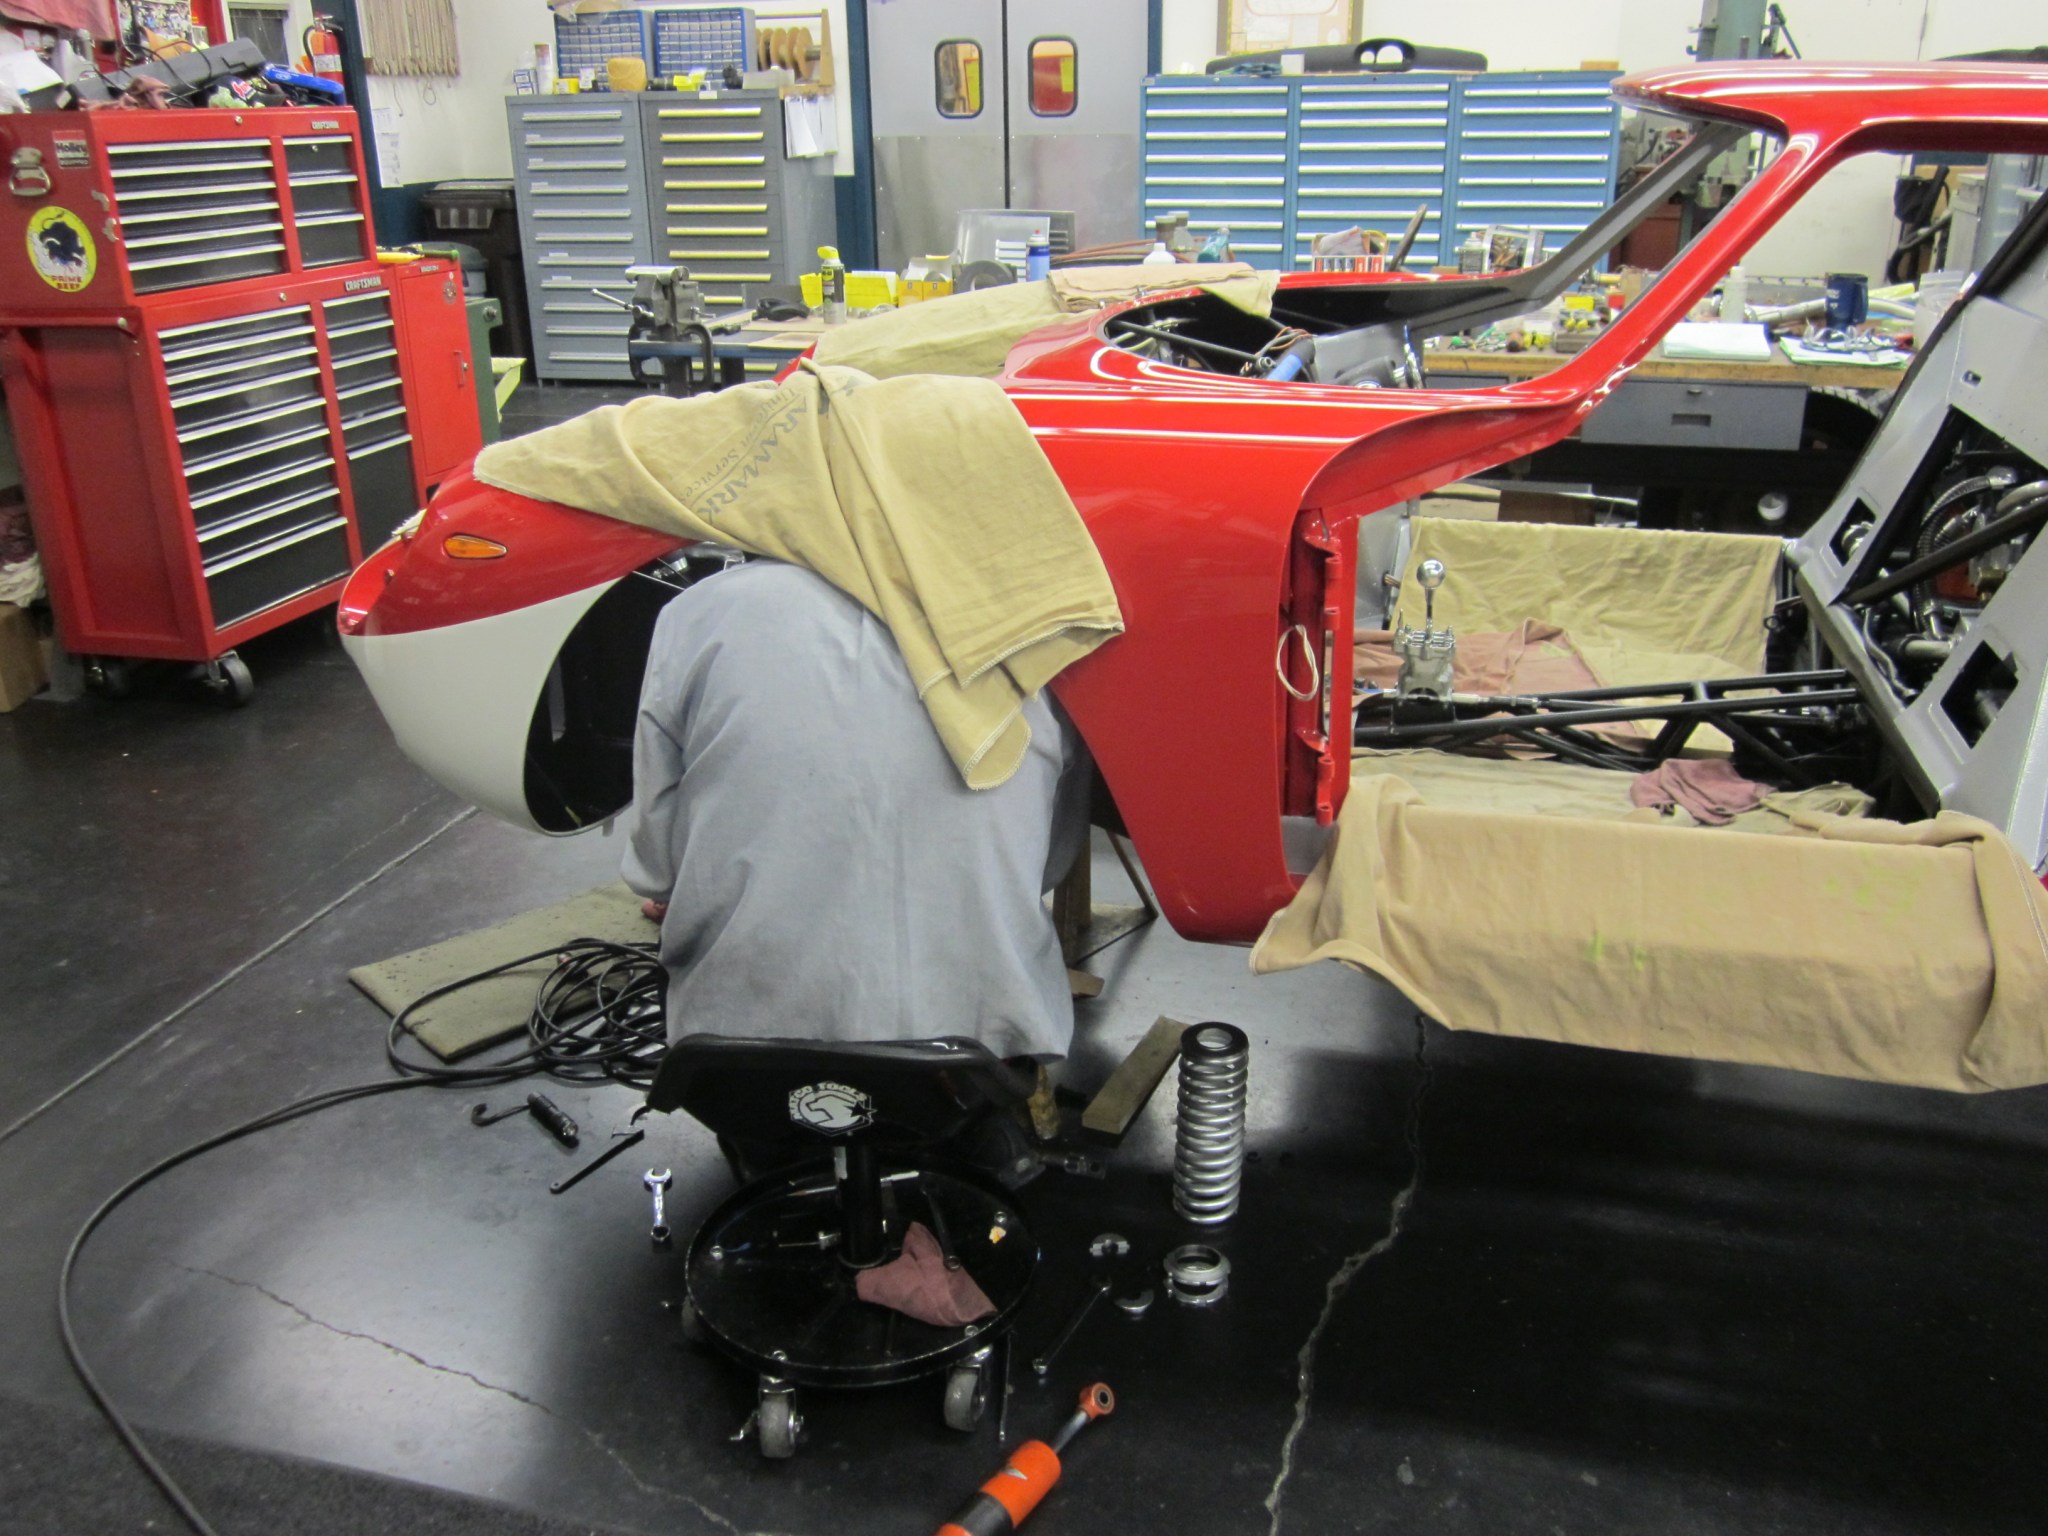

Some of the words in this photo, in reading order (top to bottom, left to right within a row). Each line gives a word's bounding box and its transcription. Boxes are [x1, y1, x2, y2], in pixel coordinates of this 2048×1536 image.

[55, 142, 87, 156] Holley
[345, 276, 382, 291] CRAFTSMAN
[741, 387, 796, 450] Uniform
[697, 395, 808, 525] ARAMARK
[788, 1085, 814, 1120] MATCO
[817, 1082, 868, 1102] TOOLS
